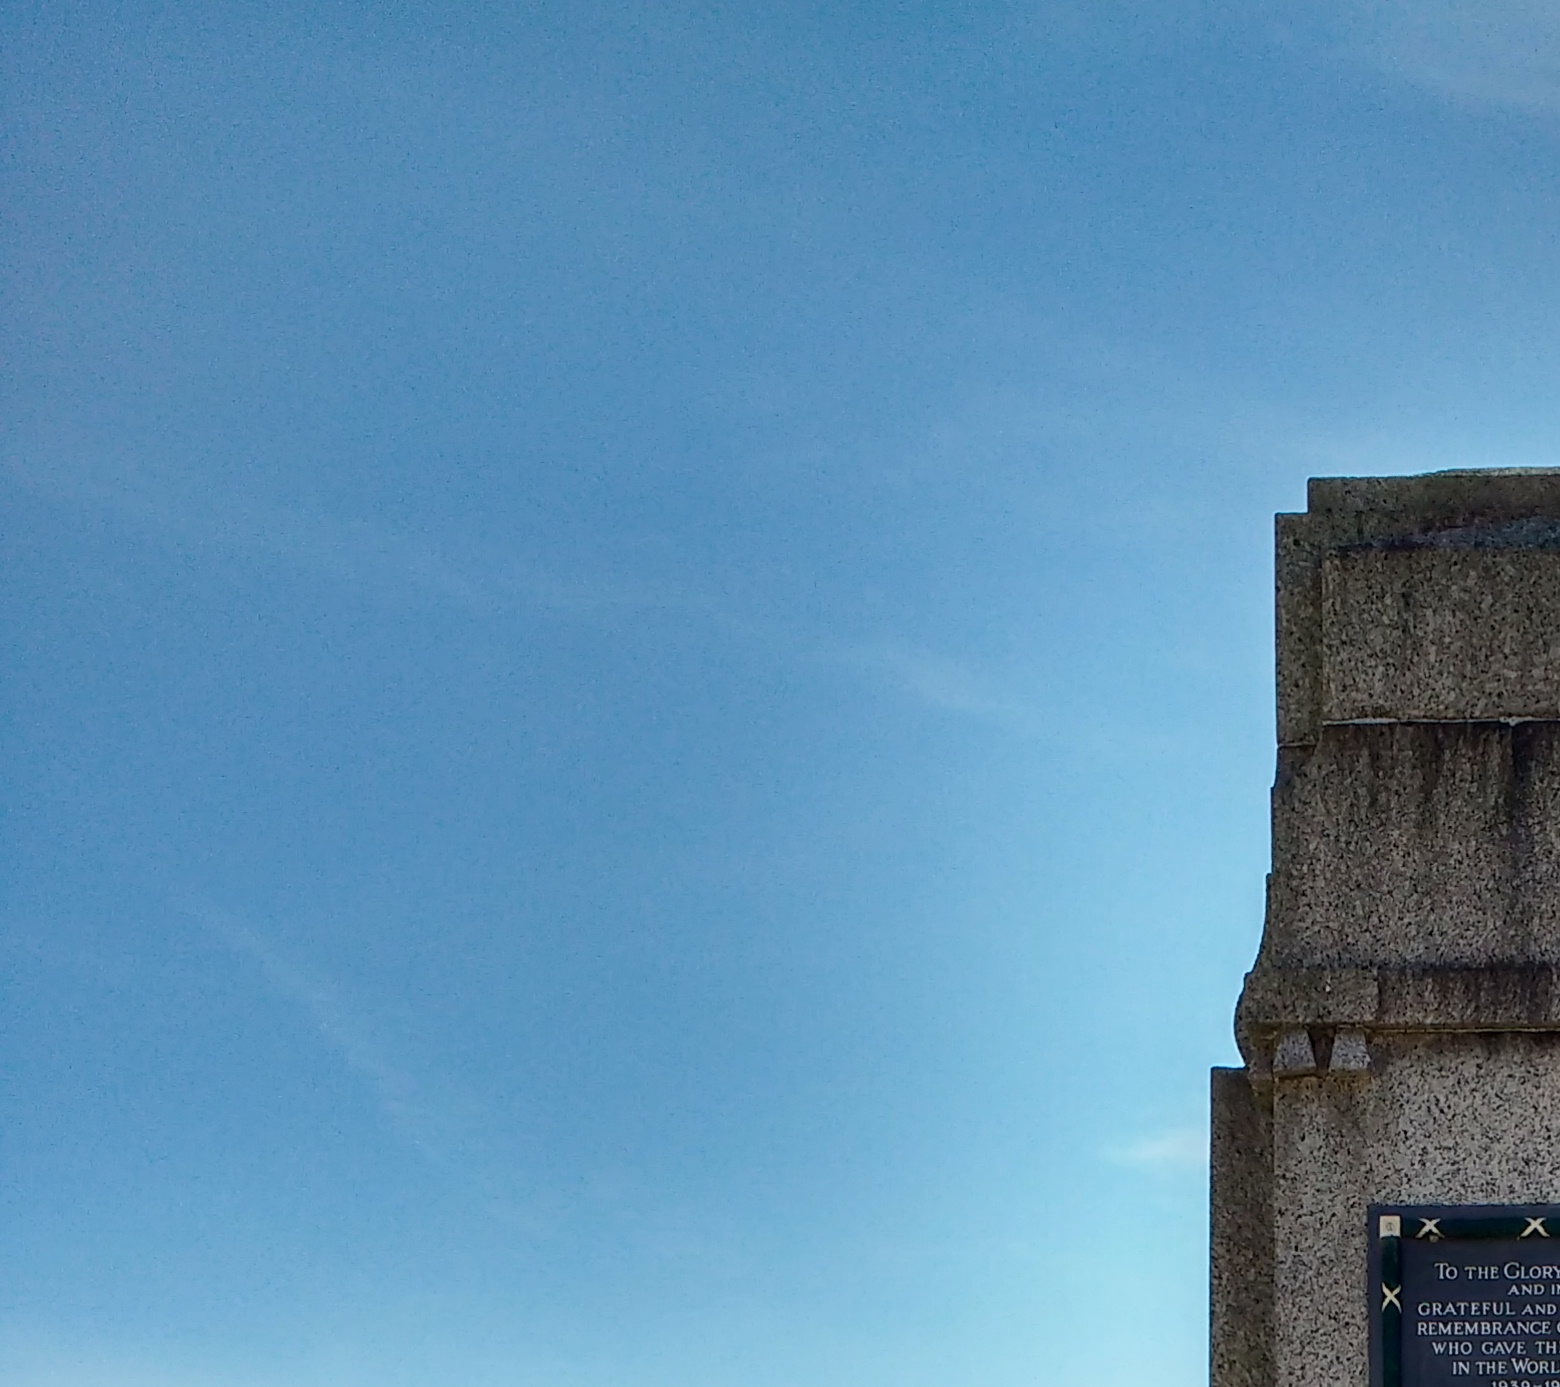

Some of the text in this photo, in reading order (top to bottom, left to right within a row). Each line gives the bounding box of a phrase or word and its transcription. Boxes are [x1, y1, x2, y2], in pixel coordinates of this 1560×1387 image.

[1434, 1262, 1458, 1280] TO
[1464, 1266, 1500, 1280] THE
[1507, 1284, 1545, 1296] AND
[1417, 1301, 1516, 1316] GRATEFUL
[1521, 1303, 1557, 1316] AND
[1417, 1321, 1551, 1336] REMEMBRANCE
[1431, 1341, 1473, 1355] WHO
[1481, 1341, 1527, 1355] GAVE
[1452, 1361, 1470, 1375] IN
[1474, 1361, 1508, 1375] THE
